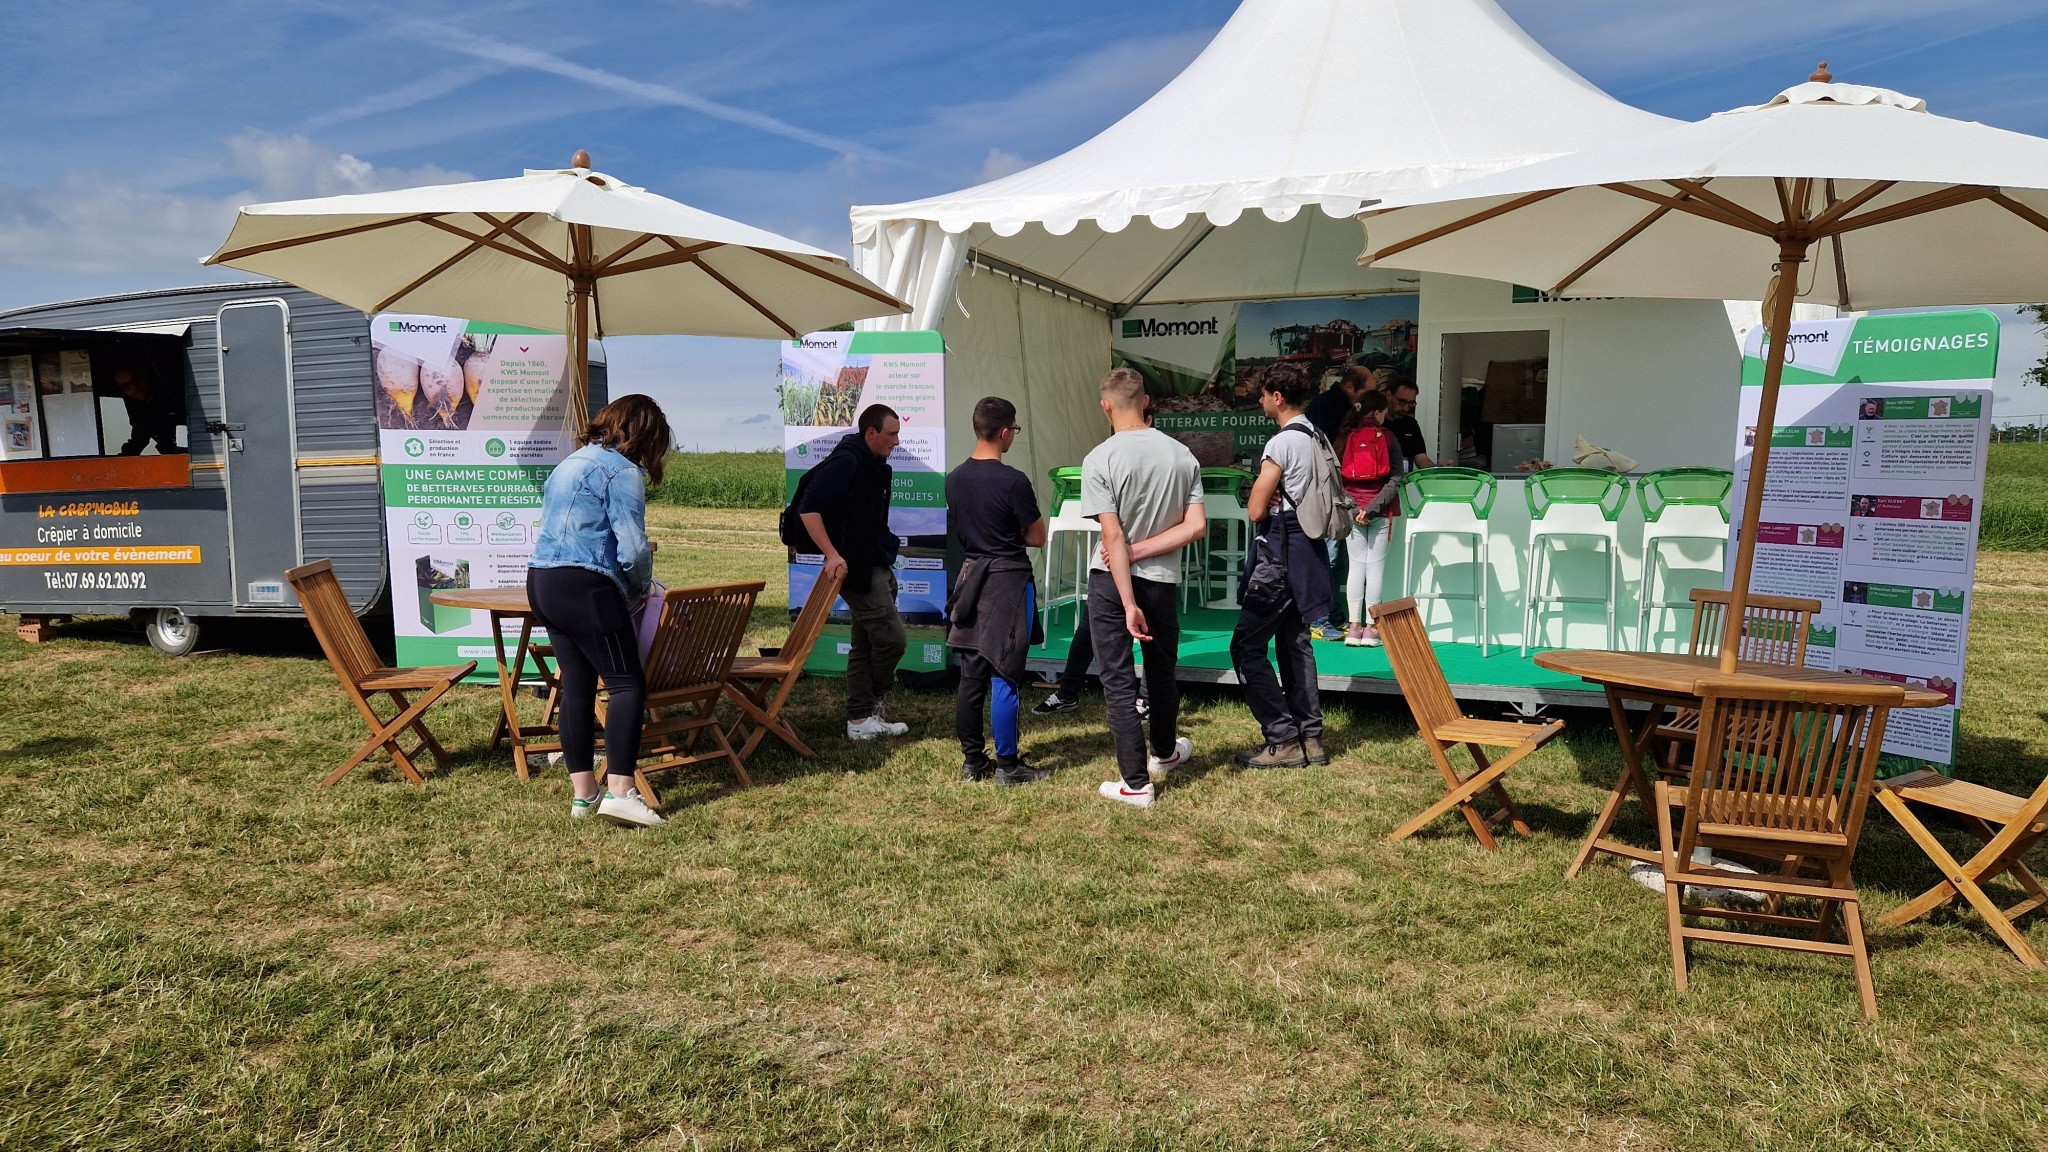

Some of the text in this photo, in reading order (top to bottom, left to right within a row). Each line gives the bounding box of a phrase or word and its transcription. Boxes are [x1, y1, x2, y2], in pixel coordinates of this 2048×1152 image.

[399, 321, 447, 333] Momont
[1140, 317, 1218, 337] Momont
[1787, 330, 1829, 343] omont
[800, 339, 838, 349] Momont
[1853, 333, 1989, 354] TÉMOIGNAGES
[501, 360, 548, 368] Depuis 1860,
[489, 378, 518, 386] dispose
[908, 383, 935, 391] français
[487, 387, 521, 395] expertise
[888, 394, 914, 402] sorghos
[508, 405, 545, 413] production
[894, 405, 926, 413] fourrages
[1154, 416, 1217, 428] ETTERAVE
[1239, 434, 1265, 445] UNE
[405, 467, 551, 481] UNE GAMME COMPLÈT
[406, 484, 420, 493] DE
[422, 484, 485, 493] BETTERAVES
[407, 494, 543, 505] PERFORMANTE ET RÉSISTA
[892, 491, 940, 501] PROJETS !
[38, 504, 56, 518] LA
[37, 522, 143, 546] Crêpier à domicile
[0, 548, 193, 563] au coeur de votre évènement
